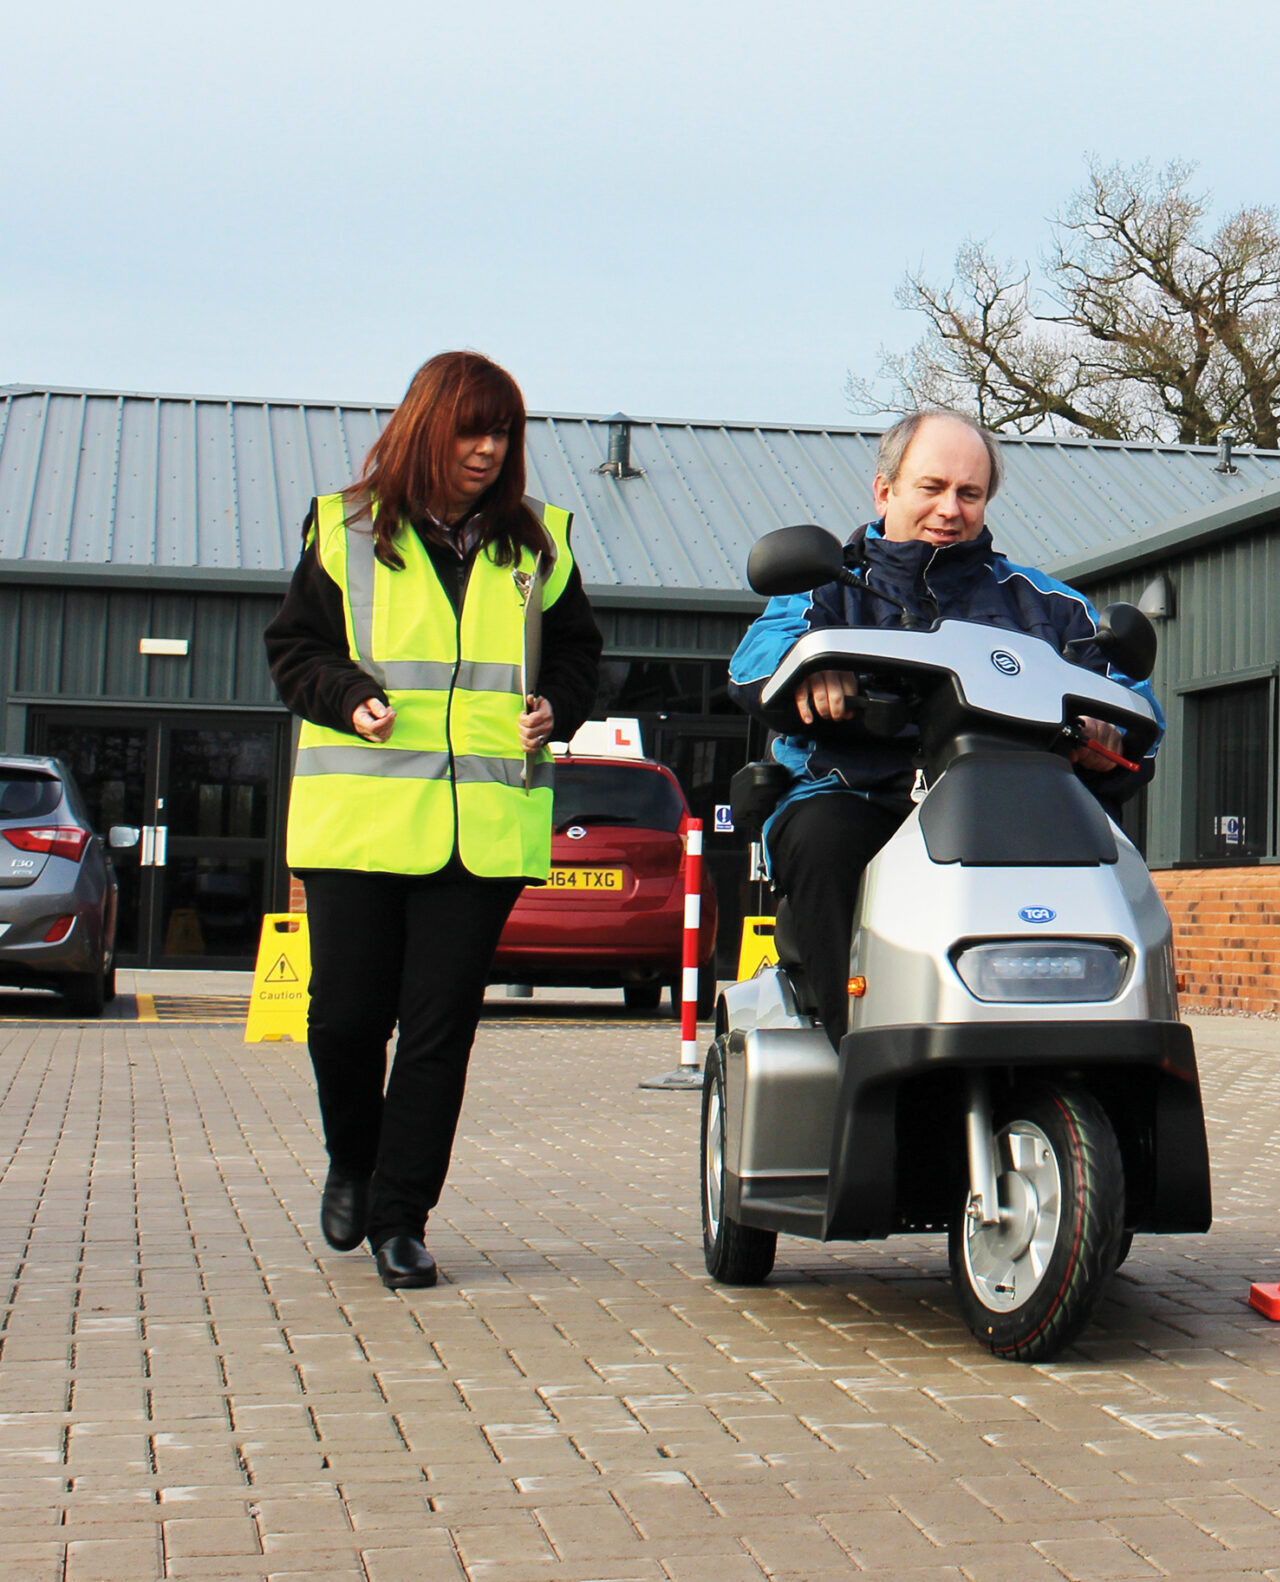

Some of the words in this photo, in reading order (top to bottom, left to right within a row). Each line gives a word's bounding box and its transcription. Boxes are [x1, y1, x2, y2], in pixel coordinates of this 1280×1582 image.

[615, 729, 630, 745] L
[582, 872, 615, 887] TXG
[1024, 909, 1049, 919] TGA
[260, 991, 302, 1000] Caution
